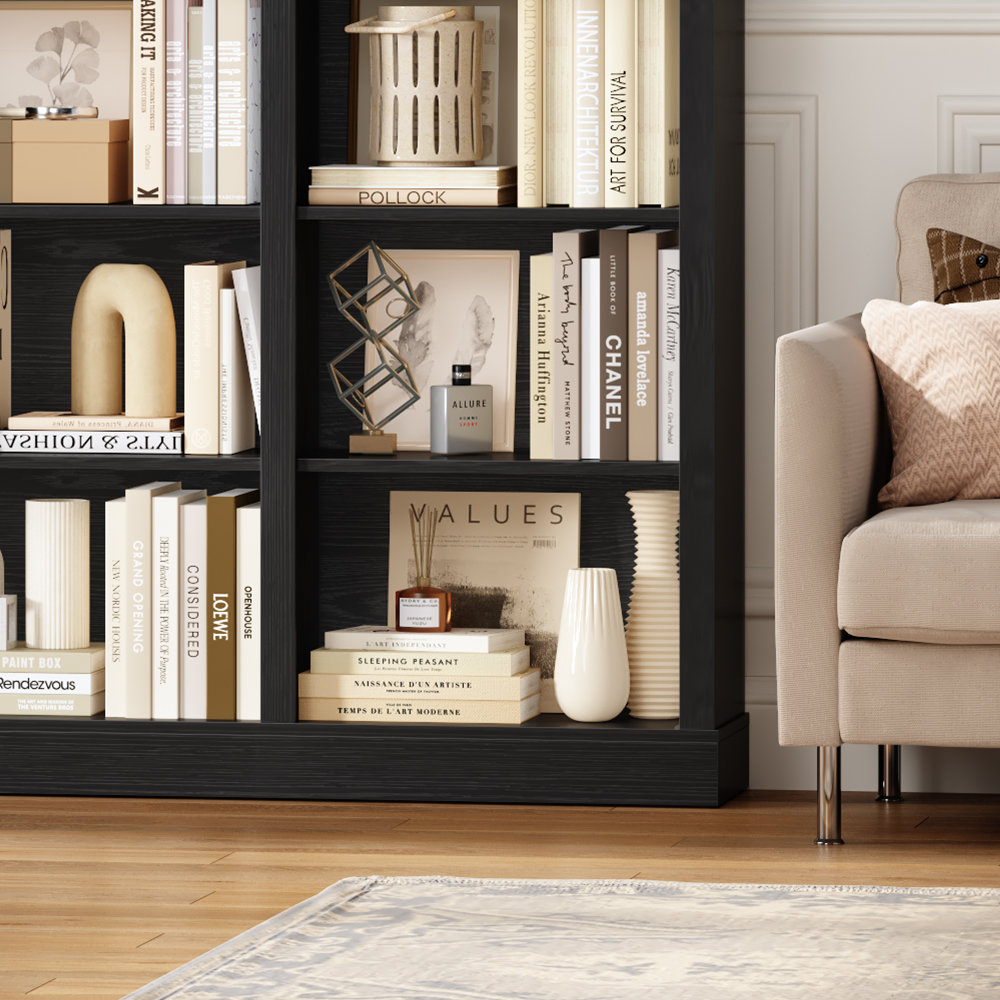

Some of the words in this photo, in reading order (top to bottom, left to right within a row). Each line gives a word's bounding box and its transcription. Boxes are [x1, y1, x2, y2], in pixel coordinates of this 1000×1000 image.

[140, 46, 156, 60] IT
[524, 80, 537, 119] LOOK
[576, 10, 599, 195] INNENARCHITEKTUR
[610, 70, 627, 132] SURVIVAL
[524, 123, 537, 156] NEW
[610, 136, 626, 164] FOR
[359, 190, 447, 204] POLLOCK
[610, 168, 626, 194] ART
[561, 251, 574, 280] The
[667, 267, 680, 300] Karen
[537, 292, 550, 345] Arianna
[610, 306, 616, 316] OF
[636, 291, 650, 347] amanda
[555, 321, 574, 366] beyond
[662, 303, 680, 361] McCartney
[533, 350, 550, 424] Huffington
[605, 334, 622, 430] CHANEL
[636, 350, 650, 407] lovelace
[452, 399, 487, 409] ALLURE
[410, 503, 564, 524] VALUES
[112, 559, 121, 581] NEW
[133, 541, 144, 587] GRAND
[112, 584, 121, 623] NORDIC
[187, 565, 199, 658] CONSIDERED
[212, 593, 228, 641] LOEWE
[244, 586, 252, 639] OPENHOUSE
[133, 592, 144, 654] OPENING
[2, 657, 35, 669] PAINT
[39, 657, 61, 669] BOX
[112, 626, 121, 663] HOUSES
[358, 657, 408, 665] SLEEPING
[412, 658, 459, 666] PEASANT
[354, 680, 406, 688] NAISSANCE
[408, 680, 431, 688] D'UN
[434, 681, 473, 689] ARTISTE
[386, 707, 413, 715] L'ART
[416, 708, 461, 716] MODERNE
